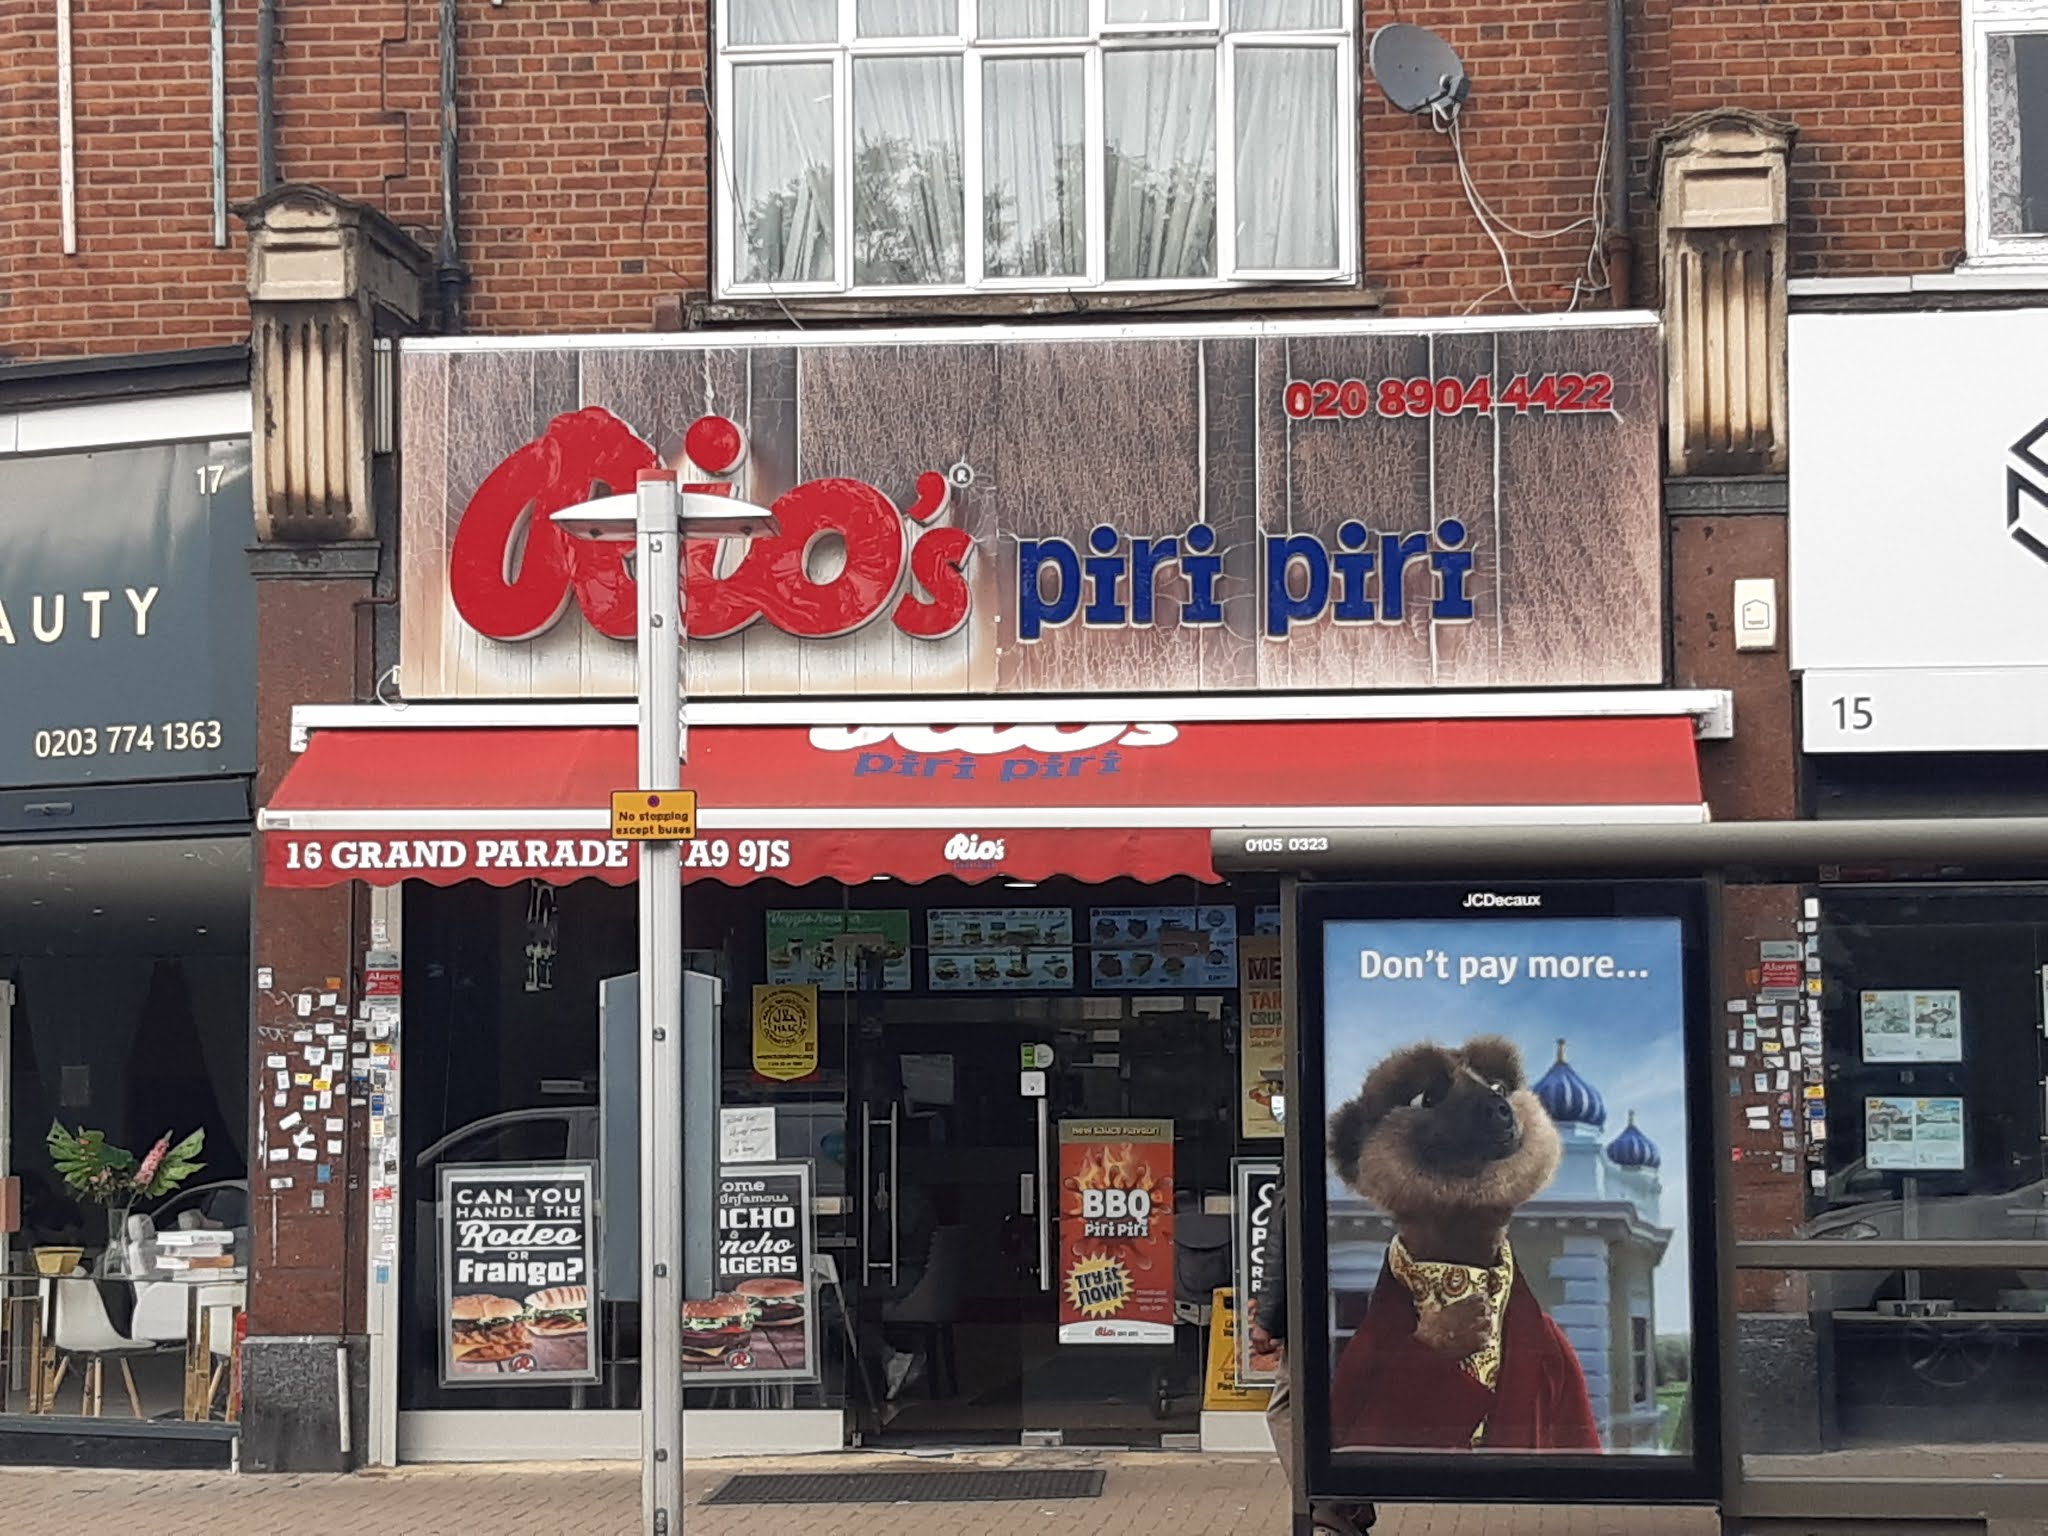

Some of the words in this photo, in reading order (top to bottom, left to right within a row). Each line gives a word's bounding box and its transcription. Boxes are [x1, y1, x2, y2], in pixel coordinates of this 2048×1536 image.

[1284, 379, 1366, 419] 020
[1378, 376, 1493, 416] 8904
[1500, 373, 1614, 413] 4422
[196, 465, 225, 495] 17
[1017, 521, 1223, 640] piri
[1265, 518, 1473, 639] piri
[1831, 696, 1873, 730] 15
[35, 728, 97, 758] 0203
[107, 725, 153, 753] 774
[162, 721, 222, 750] 1363
[854, 752, 976, 780] piri
[1000, 751, 1123, 782] piri
[616, 825, 655, 836] except
[658, 825, 691, 835] buses
[618, 811, 636, 822] No
[639, 811, 689, 823] stopping
[287, 842, 322, 870] 16
[331, 841, 468, 870] GRAND
[475, 840, 629, 869] PARADE
[679, 840, 730, 868] A9
[738, 839, 790, 872] 9JS
[944, 833, 1005, 860] Rio's
[1245, 839, 1283, 852] 0105
[1288, 837, 1329, 851] 0323
[1463, 893, 1541, 907] JCDecaux
[1361, 949, 1449, 978] Don't
[1459, 955, 1519, 984] pay
[1528, 955, 1649, 978] more...
[456, 1188, 513, 1205] CAN
[525, 1187, 581, 1204] YOU
[720, 1180, 765, 1192] ome
[456, 1206, 536, 1219] HANDLE
[543, 1205, 581, 1218] THE
[1083, 1189, 1150, 1225] BBQ
[459, 1219, 582, 1254] Rodeo
[719, 1231, 795, 1255] ncho
[507, 1251, 529, 1260] OR
[458, 1257, 583, 1286] Frango?
